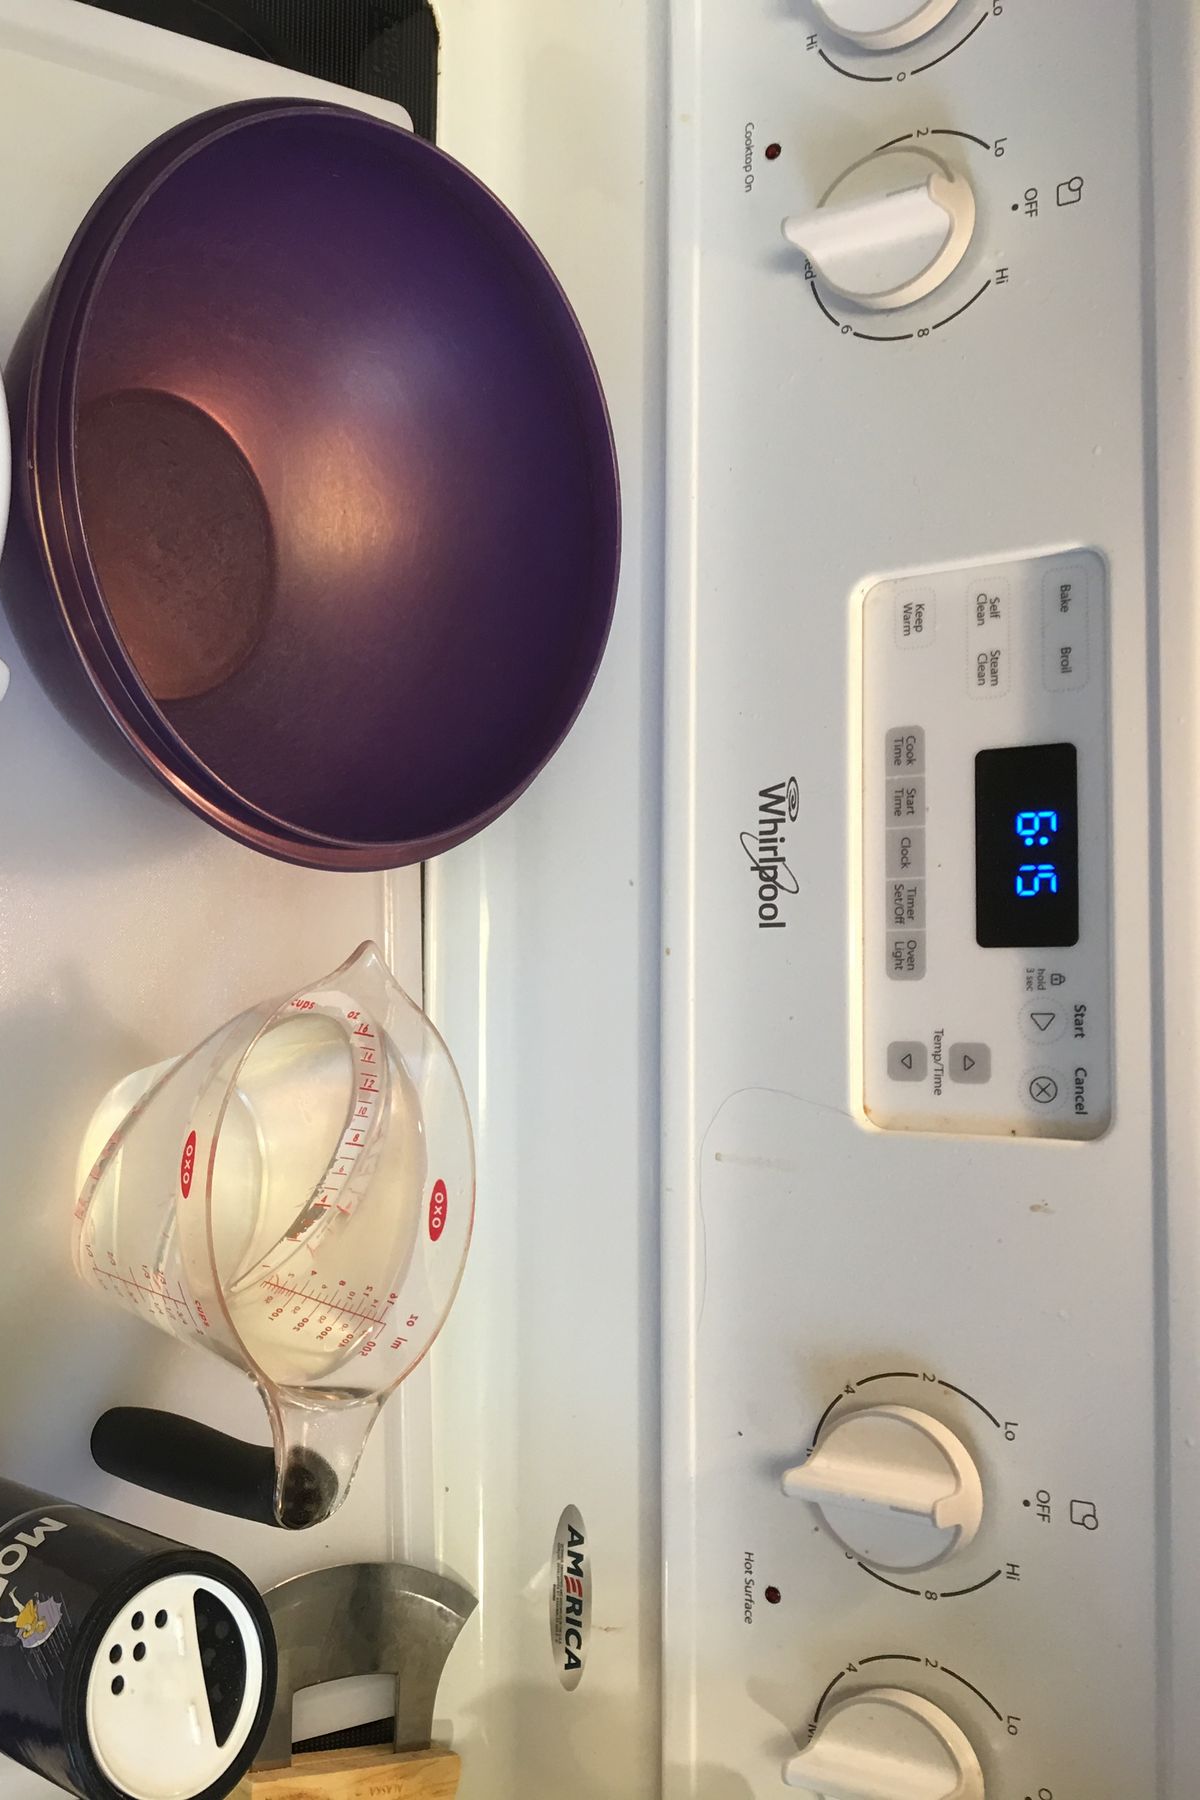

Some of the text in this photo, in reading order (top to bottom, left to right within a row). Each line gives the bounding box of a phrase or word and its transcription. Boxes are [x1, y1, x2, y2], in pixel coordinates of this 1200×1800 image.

[806, 34, 818, 51] Hi
[916, 127, 929, 138] 2
[994, 137, 1008, 157] Lo
[743, 122, 755, 193] Cooktop On
[1024, 187, 1038, 218] OFF
[805, 259, 817, 280] ed
[995, 267, 1009, 285] Hi
[840, 325, 853, 334] 6
[917, 328, 930, 338] 8
[977, 593, 987, 626] Clean
[990, 597, 1000, 619] Self
[1060, 584, 1071, 613] Bake
[903, 602, 913, 636] Warm
[913, 603, 925, 633] Keep
[977, 653, 988, 686] Clean
[990, 650, 1000, 686] Steam
[1060, 647, 1072, 674] Broil
[894, 737, 904, 766] Time
[906, 735, 917, 766] Cook
[894, 788, 904, 817] Time
[906, 788, 917, 815] Start
[749, 781, 788, 928] Whirlpool
[900, 837, 912, 869] Clock
[1016, 811, 1057, 897] 6:15
[894, 884, 905, 925] Set/Off
[907, 887, 917, 920] Timer
[892, 941, 905, 971] Light
[906, 940, 917, 971] Oven
[1037, 968, 1046, 990] hold
[1074, 1004, 1087, 1038] Start
[932, 1028, 944, 1096] Temp/Time
[1074, 1067, 1088, 1115] Cancel
[182, 1145, 194, 1184] OXO
[431, 1192, 444, 1229] OXO
[195, 1300, 210, 1327] cups
[844, 1384, 856, 1395] 4
[922, 1372, 936, 1383] 2
[1005, 1422, 1019, 1441] Lo
[1036, 1489, 1051, 1523] OFF
[1006, 1562, 1020, 1581] Hi
[564, 1524, 585, 1671] AMERICA
[744, 1551, 755, 1625] Hot Surface
[925, 1590, 937, 1600] 8
[846, 1662, 858, 1673] 4
[925, 1657, 938, 1668] 2
[1007, 1715, 1021, 1736] Lo
